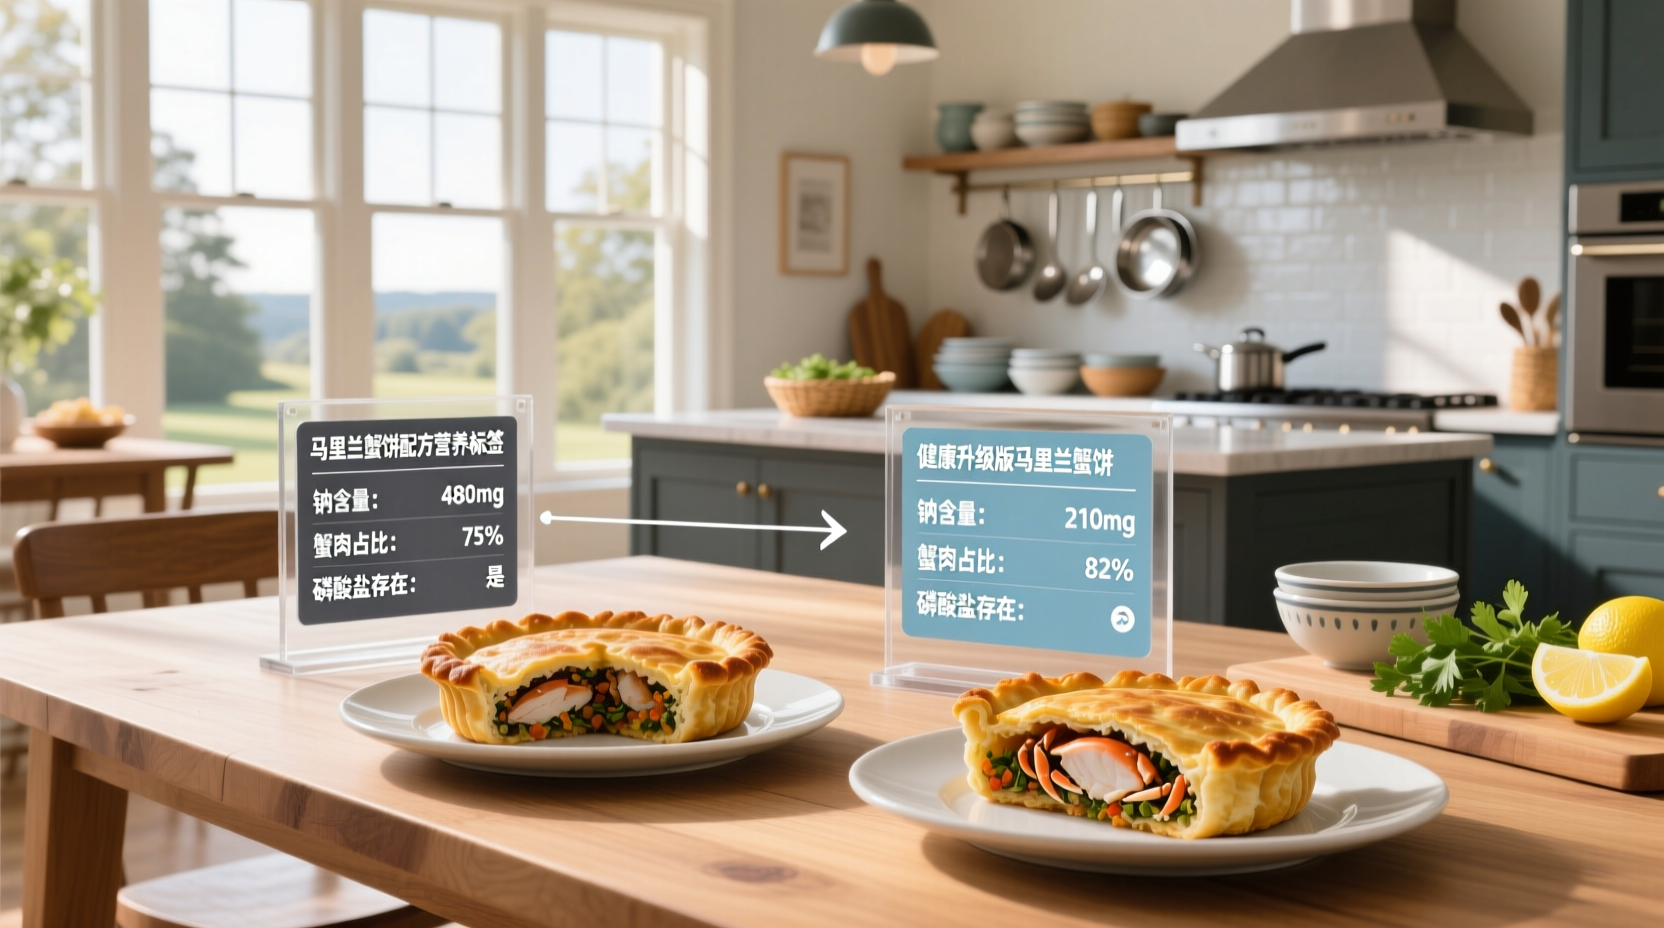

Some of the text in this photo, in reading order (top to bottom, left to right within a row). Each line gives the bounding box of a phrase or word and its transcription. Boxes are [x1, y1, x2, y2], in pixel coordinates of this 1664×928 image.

[310, 430, 504, 461] 马里兰蟹饼配方营养标签
[917, 443, 1113, 476] 健康升级版马里兰蟹饼
[313, 484, 503, 514] 钠含量： 480mg
[917, 498, 1135, 538] 钠含量： 210mg
[314, 525, 503, 558] 蟹肉占比： 75%
[486, 565, 504, 588] 是
[917, 544, 1133, 581] 蟹肉占比： 82%
